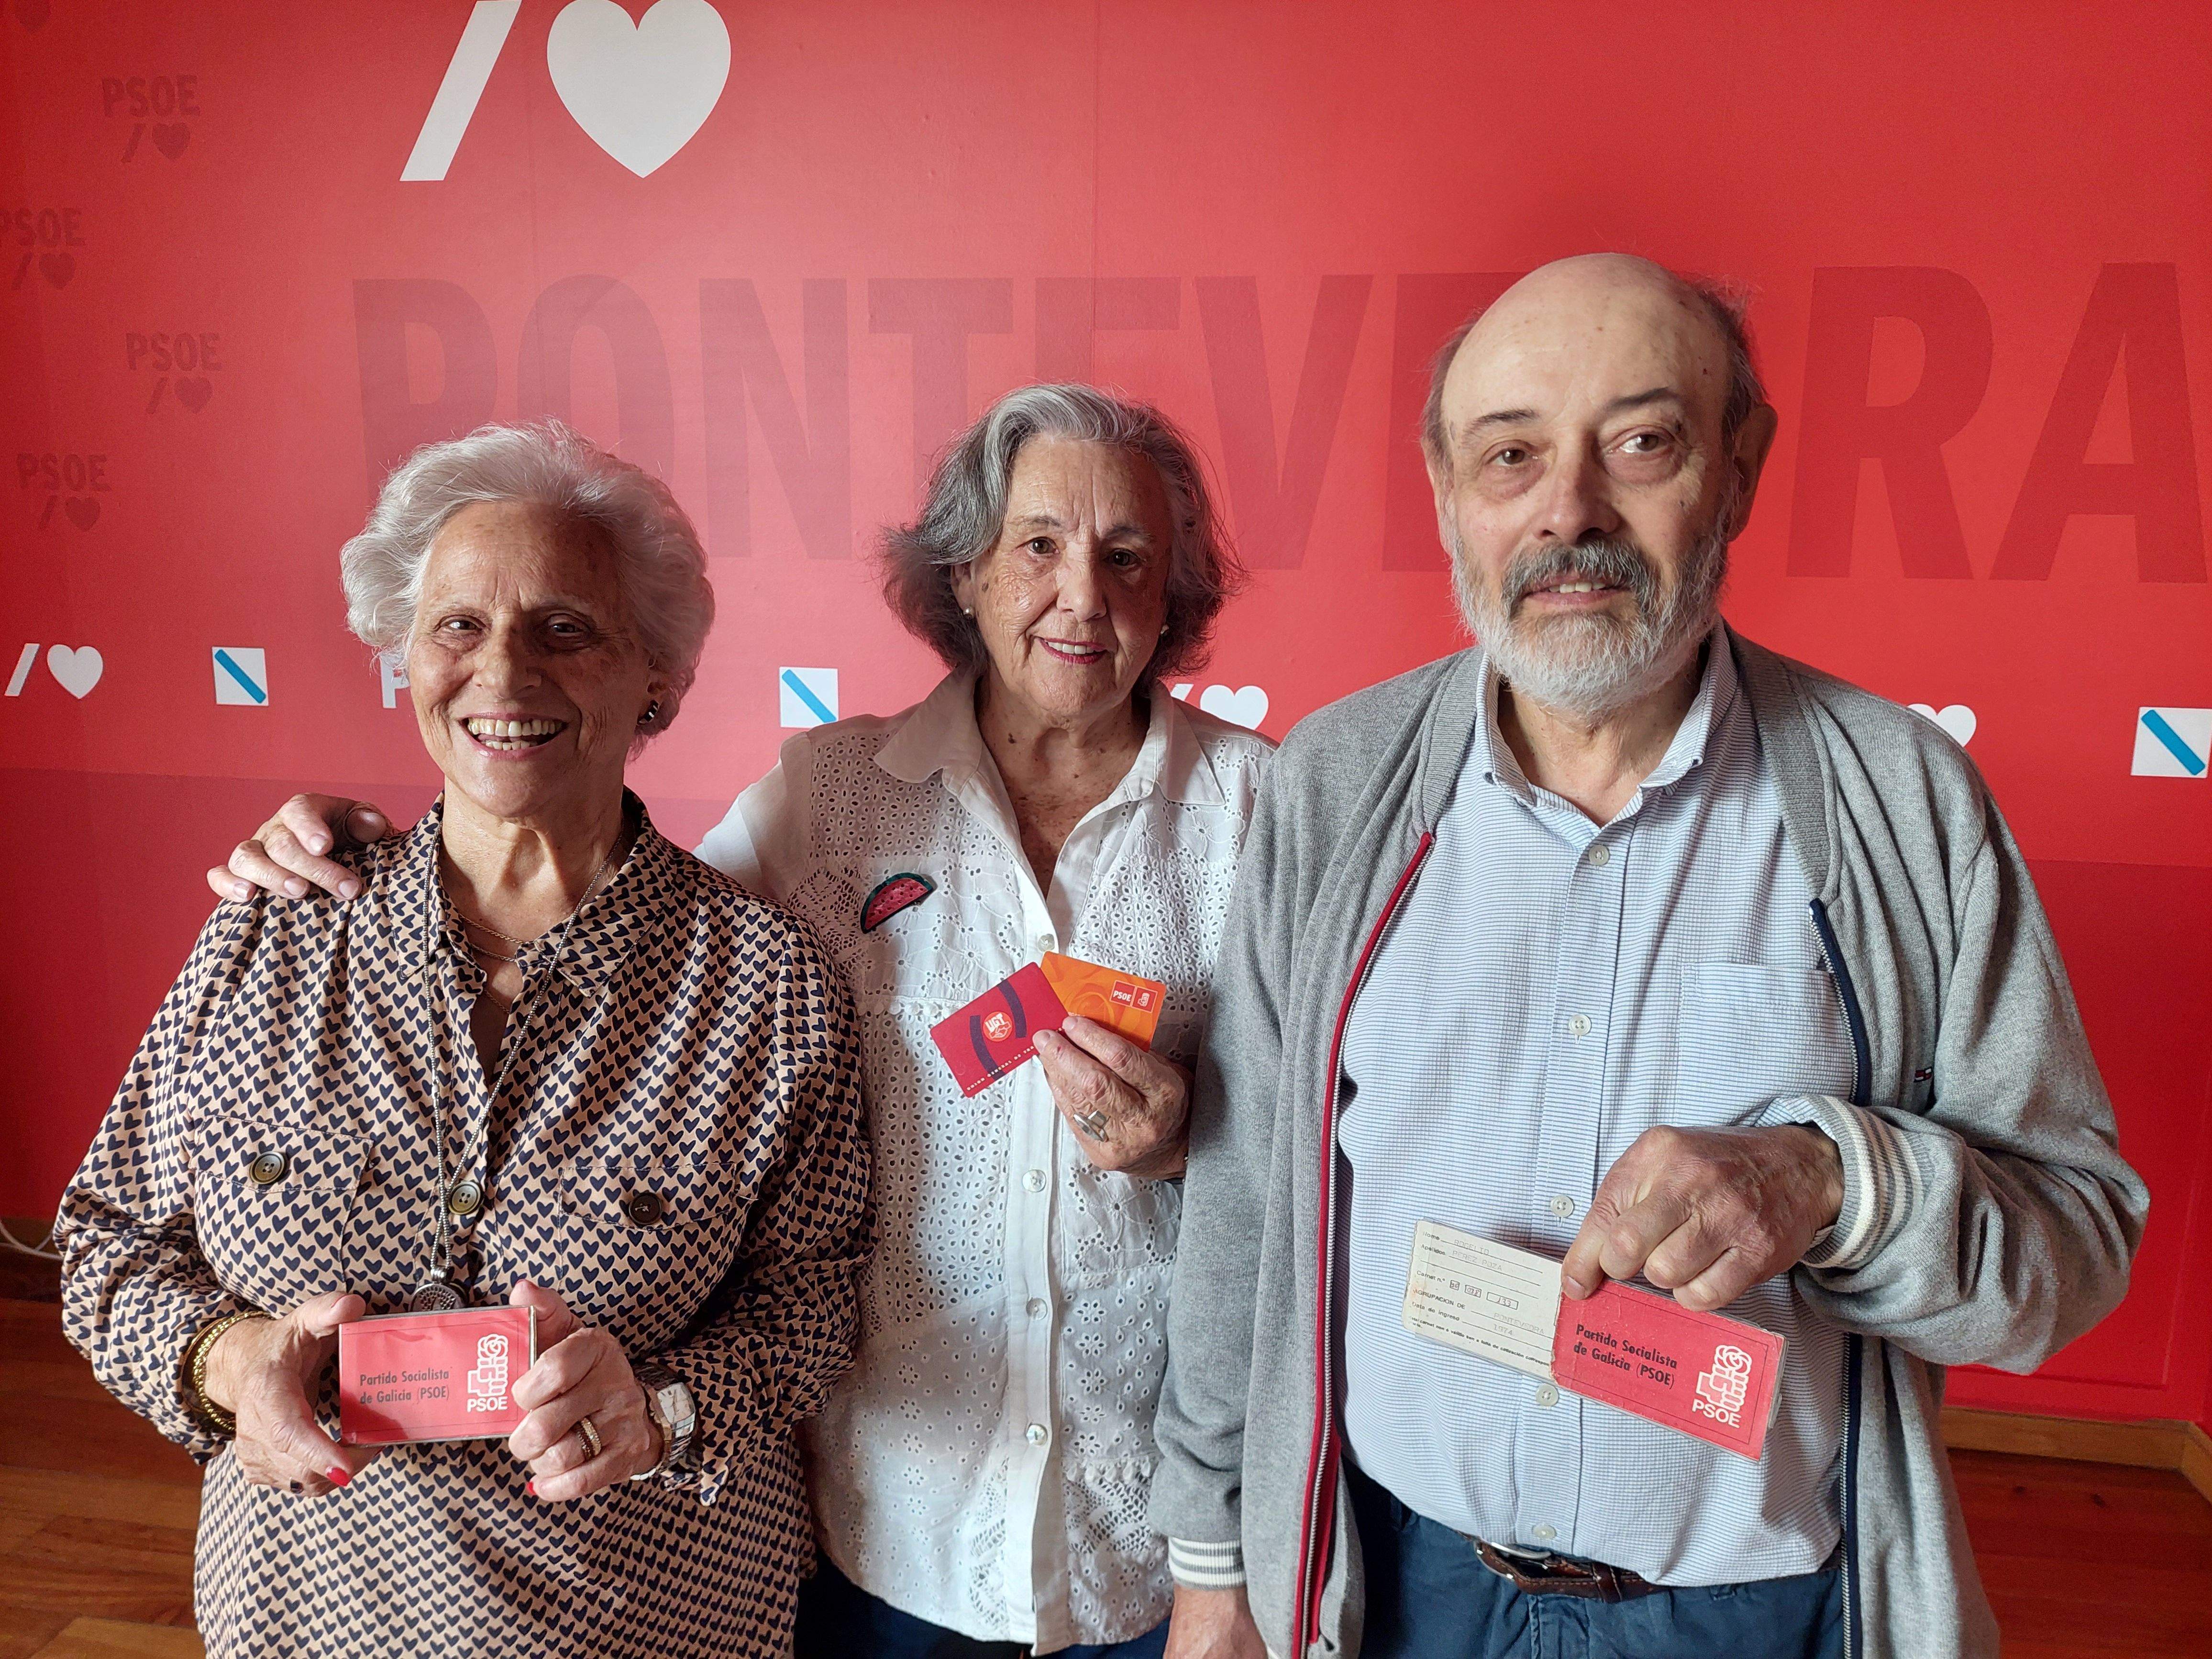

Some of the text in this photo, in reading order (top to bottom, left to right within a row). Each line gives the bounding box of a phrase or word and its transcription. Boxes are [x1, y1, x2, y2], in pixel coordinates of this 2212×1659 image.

[101, 75, 200, 117] PSOE
[125, 332, 222, 372] PSOE
[15, 452, 111, 493] PSOE
[1113, 990, 1132, 1002] PSOE
[985, 1013, 1005, 1033] UGT
[1416, 1270, 1436, 1281] Carnet
[1412, 1301, 1425, 1310] Data
[1438, 1310, 1460, 1321] ingreso
[1493, 1324, 1513, 1336] 1974
[1573, 1342, 1675, 1390] de Galicia (PSOE)
[1622, 1339, 1678, 1370] Socialista
[360, 1368, 450, 1386] Partido Socialista
[360, 1385, 450, 1405] de Galicia (PSOE)
[466, 1396, 508, 1412] PSOE
[1691, 1398, 1742, 1429] PSOE
